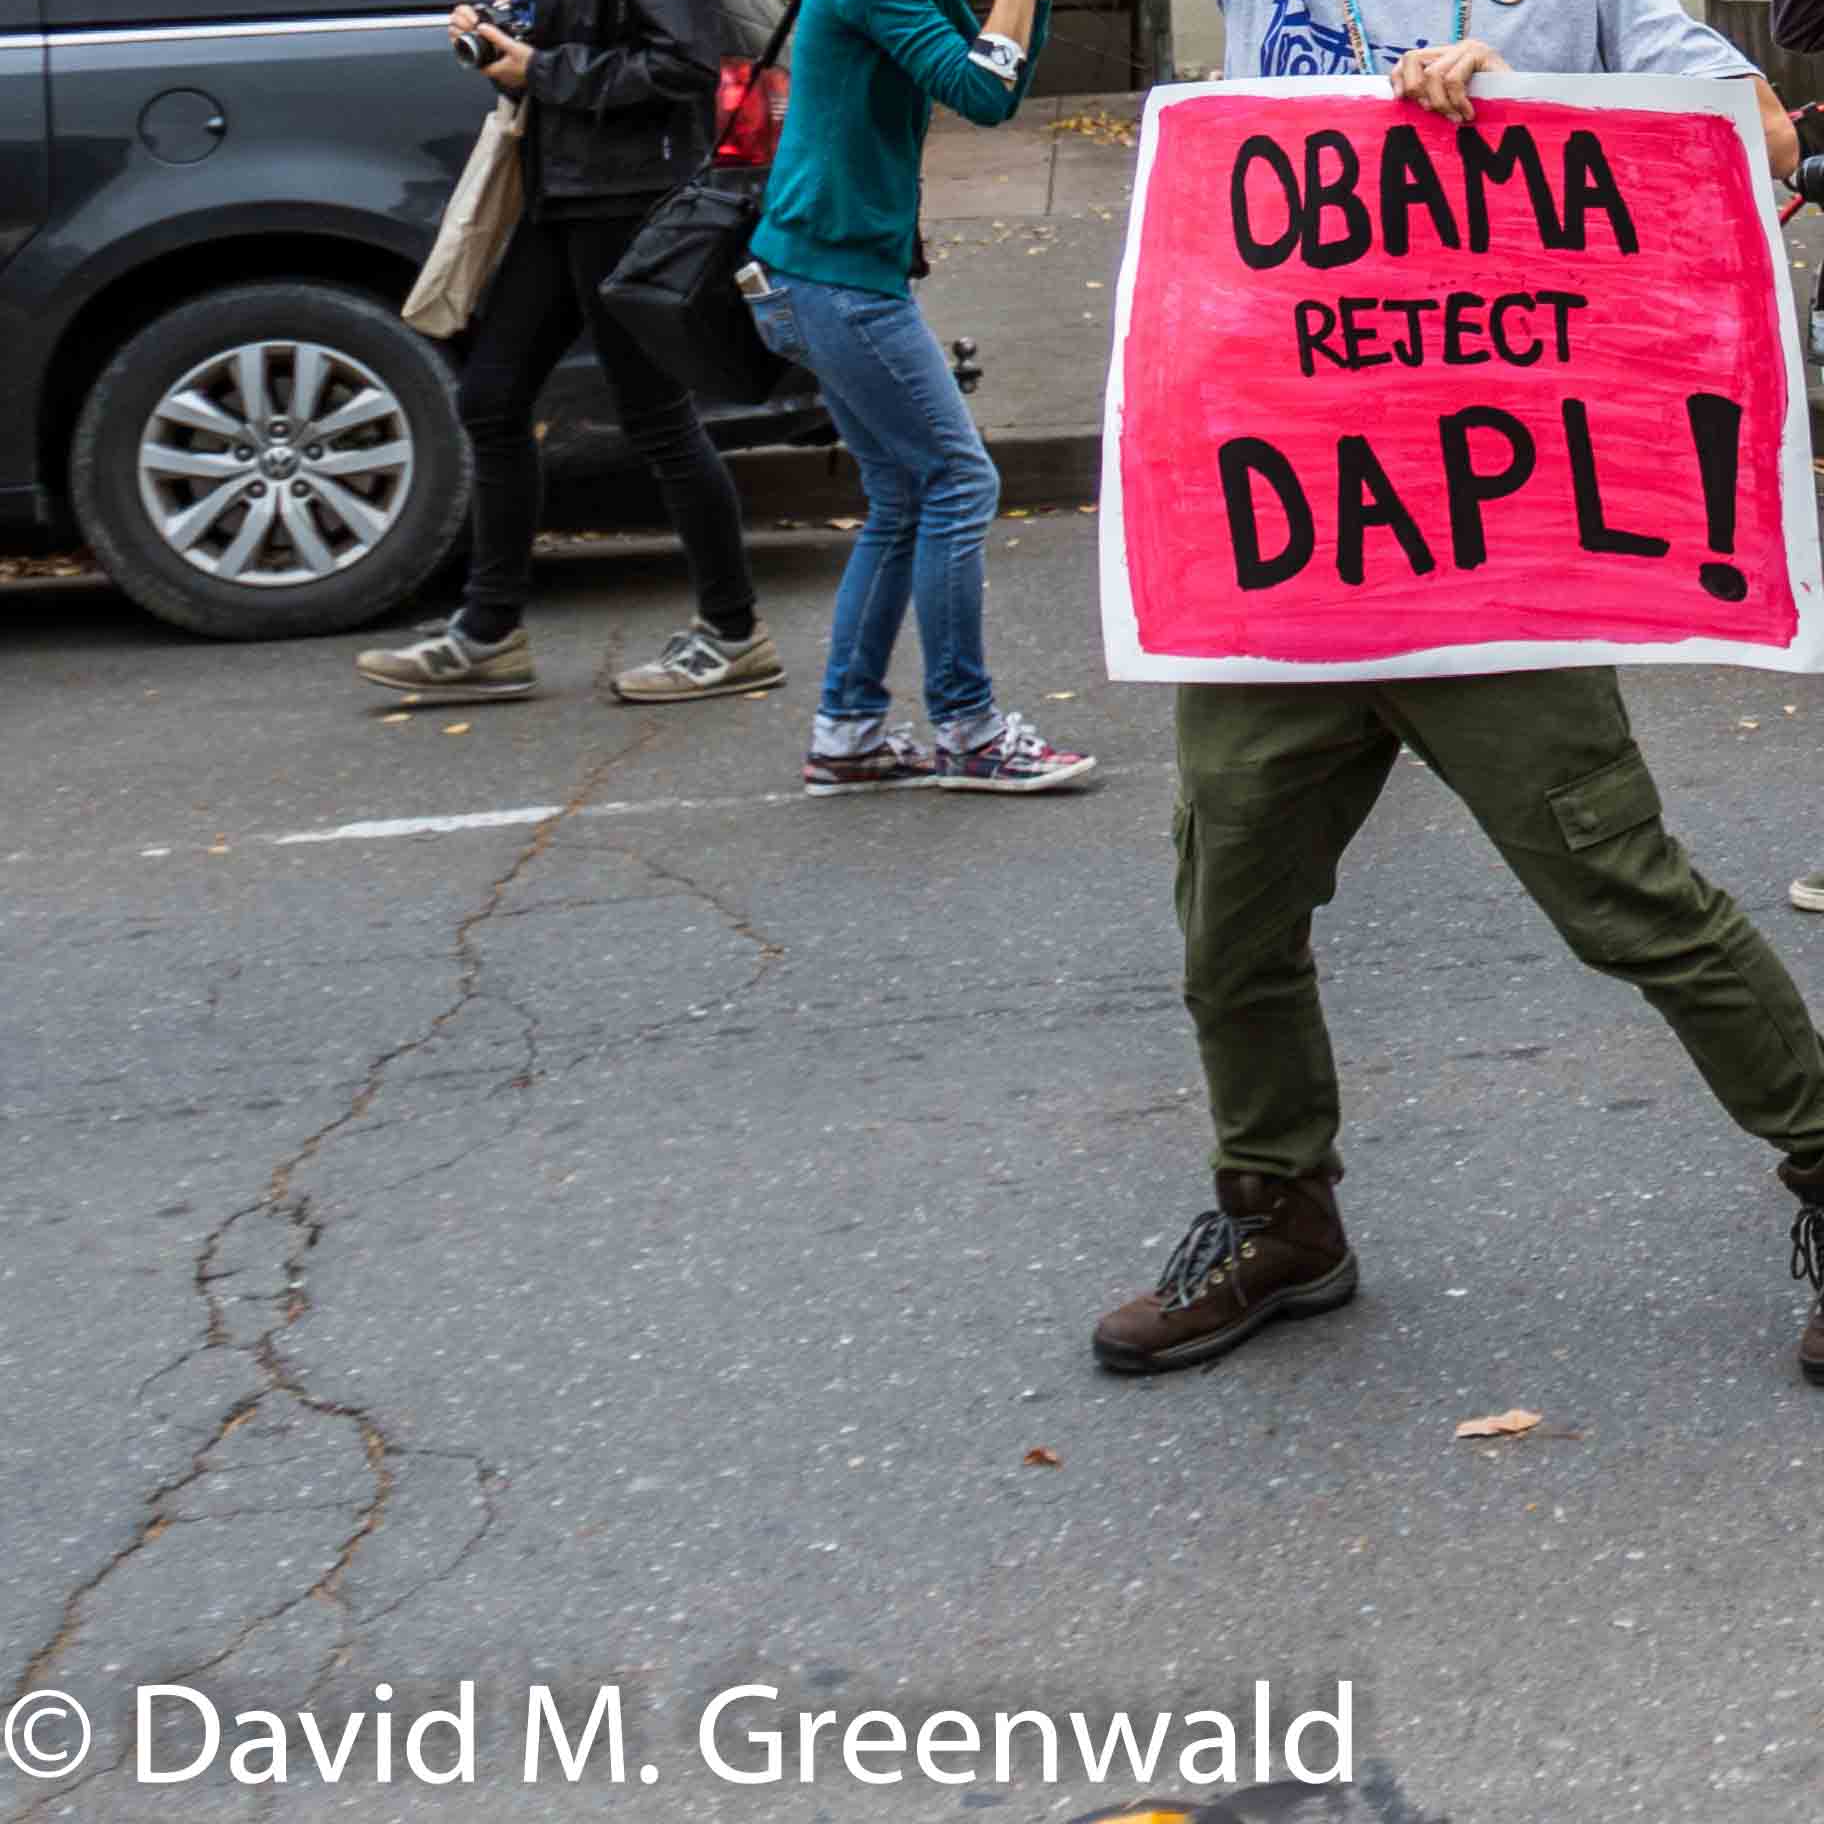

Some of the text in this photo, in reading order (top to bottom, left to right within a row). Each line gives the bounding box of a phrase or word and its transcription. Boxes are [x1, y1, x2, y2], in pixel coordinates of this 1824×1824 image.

[1230, 123, 1640, 271] OBAMA
[1294, 291, 1589, 376] REJECT
[1218, 393, 1748, 602] DAPL!
